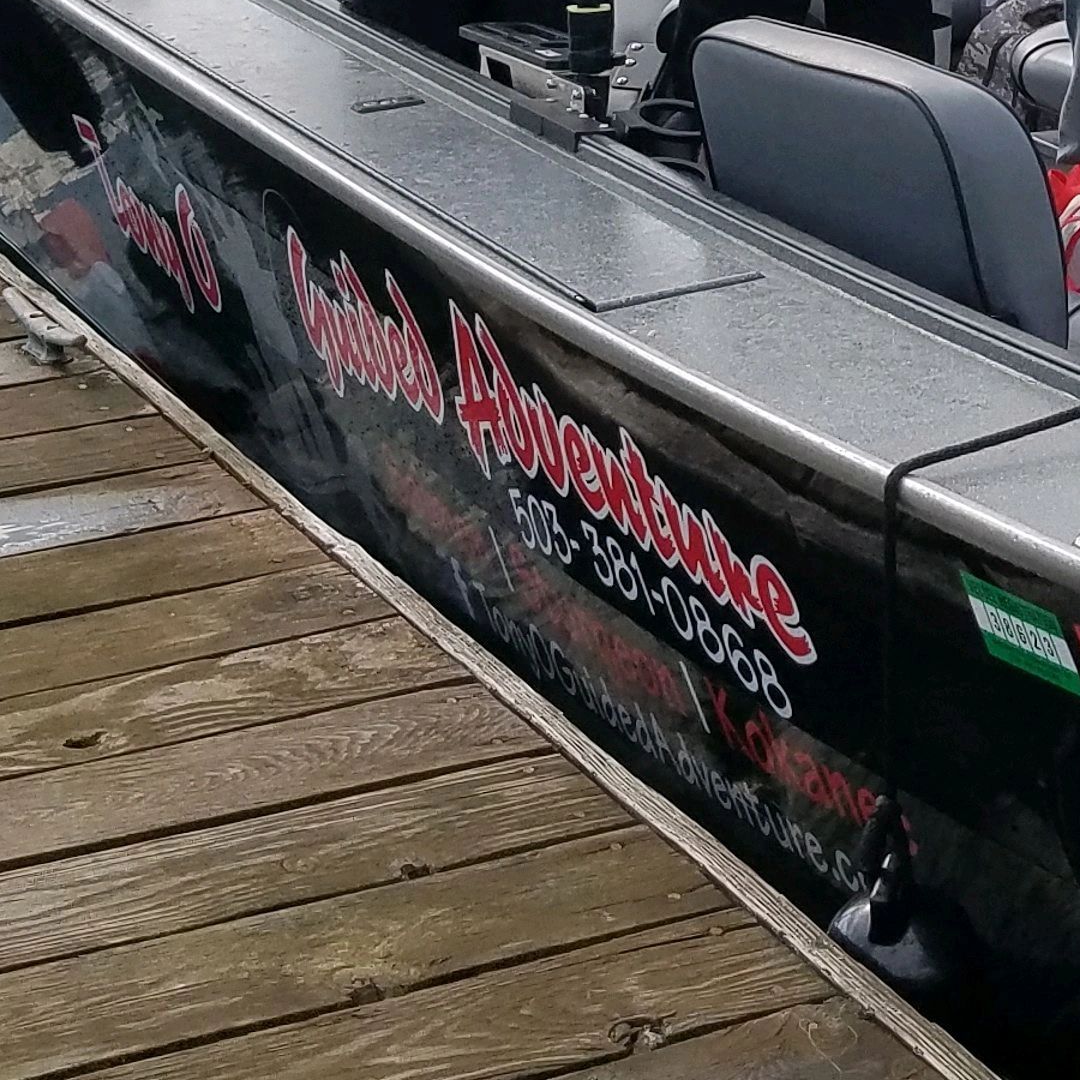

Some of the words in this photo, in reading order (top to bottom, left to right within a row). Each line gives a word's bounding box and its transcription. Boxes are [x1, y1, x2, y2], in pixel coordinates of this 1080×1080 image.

[286, 224, 444, 425] Guided
[449, 299, 817, 664] Adventure
[987, 610, 1058, 659] 38623
